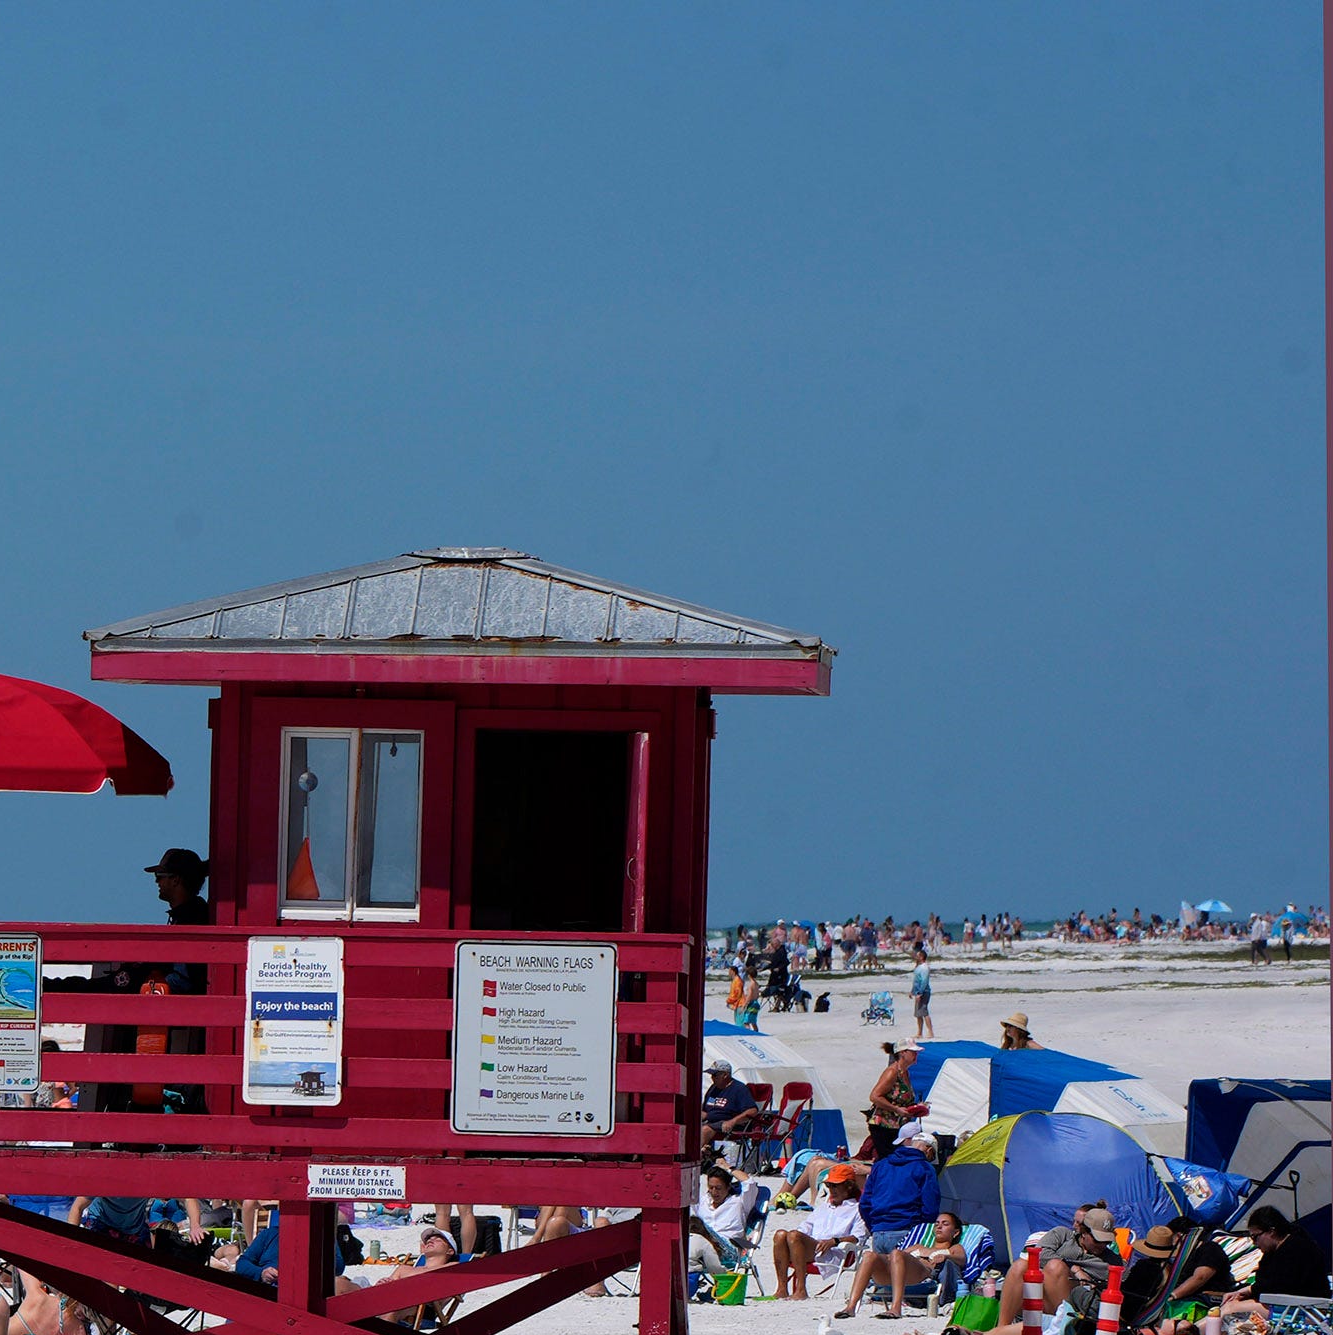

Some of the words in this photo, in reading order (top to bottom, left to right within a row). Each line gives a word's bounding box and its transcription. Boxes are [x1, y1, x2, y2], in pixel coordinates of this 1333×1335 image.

[262, 962, 292, 970] Florida
[294, 962, 327, 972] Healthy
[480, 955, 511, 968] BEACH
[516, 956, 559, 968] WARNING
[563, 957, 594, 969] FLAGS
[258, 970, 293, 978] Beaches
[294, 970, 331, 979] Program
[500, 982, 522, 991] Water
[524, 982, 551, 992] Closed
[552, 983, 560, 992] to
[563, 983, 586, 993] Public
[255, 1001, 282, 1012] Enjoy
[284, 1001, 300, 1011] the
[301, 1001, 333, 1011] beach!
[499, 1008, 516, 1019] High
[518, 1008, 545, 1017] Hazard
[498, 1036, 530, 1045] Medium
[533, 1036, 562, 1045] Hazard
[497, 1063, 515, 1072] Low
[517, 1064, 548, 1073] Hazard
[496, 1089, 539, 1102] Dangerous
[541, 1091, 568, 1100] Marine
[570, 1091, 584, 1101] Life
[322, 1168, 350, 1176] PLEASE
[352, 1168, 372, 1177] KEEP
[373, 1169, 379, 1177] 6
[380, 1169, 391, 1177] FT.
[318, 1177, 356, 1186] MINIMUM
[357, 1178, 394, 1187] DISTANCE
[310, 1186, 332, 1195] FROM
[334, 1187, 376, 1196] LIFEGUARD
[378, 1188, 403, 1196] STAND
